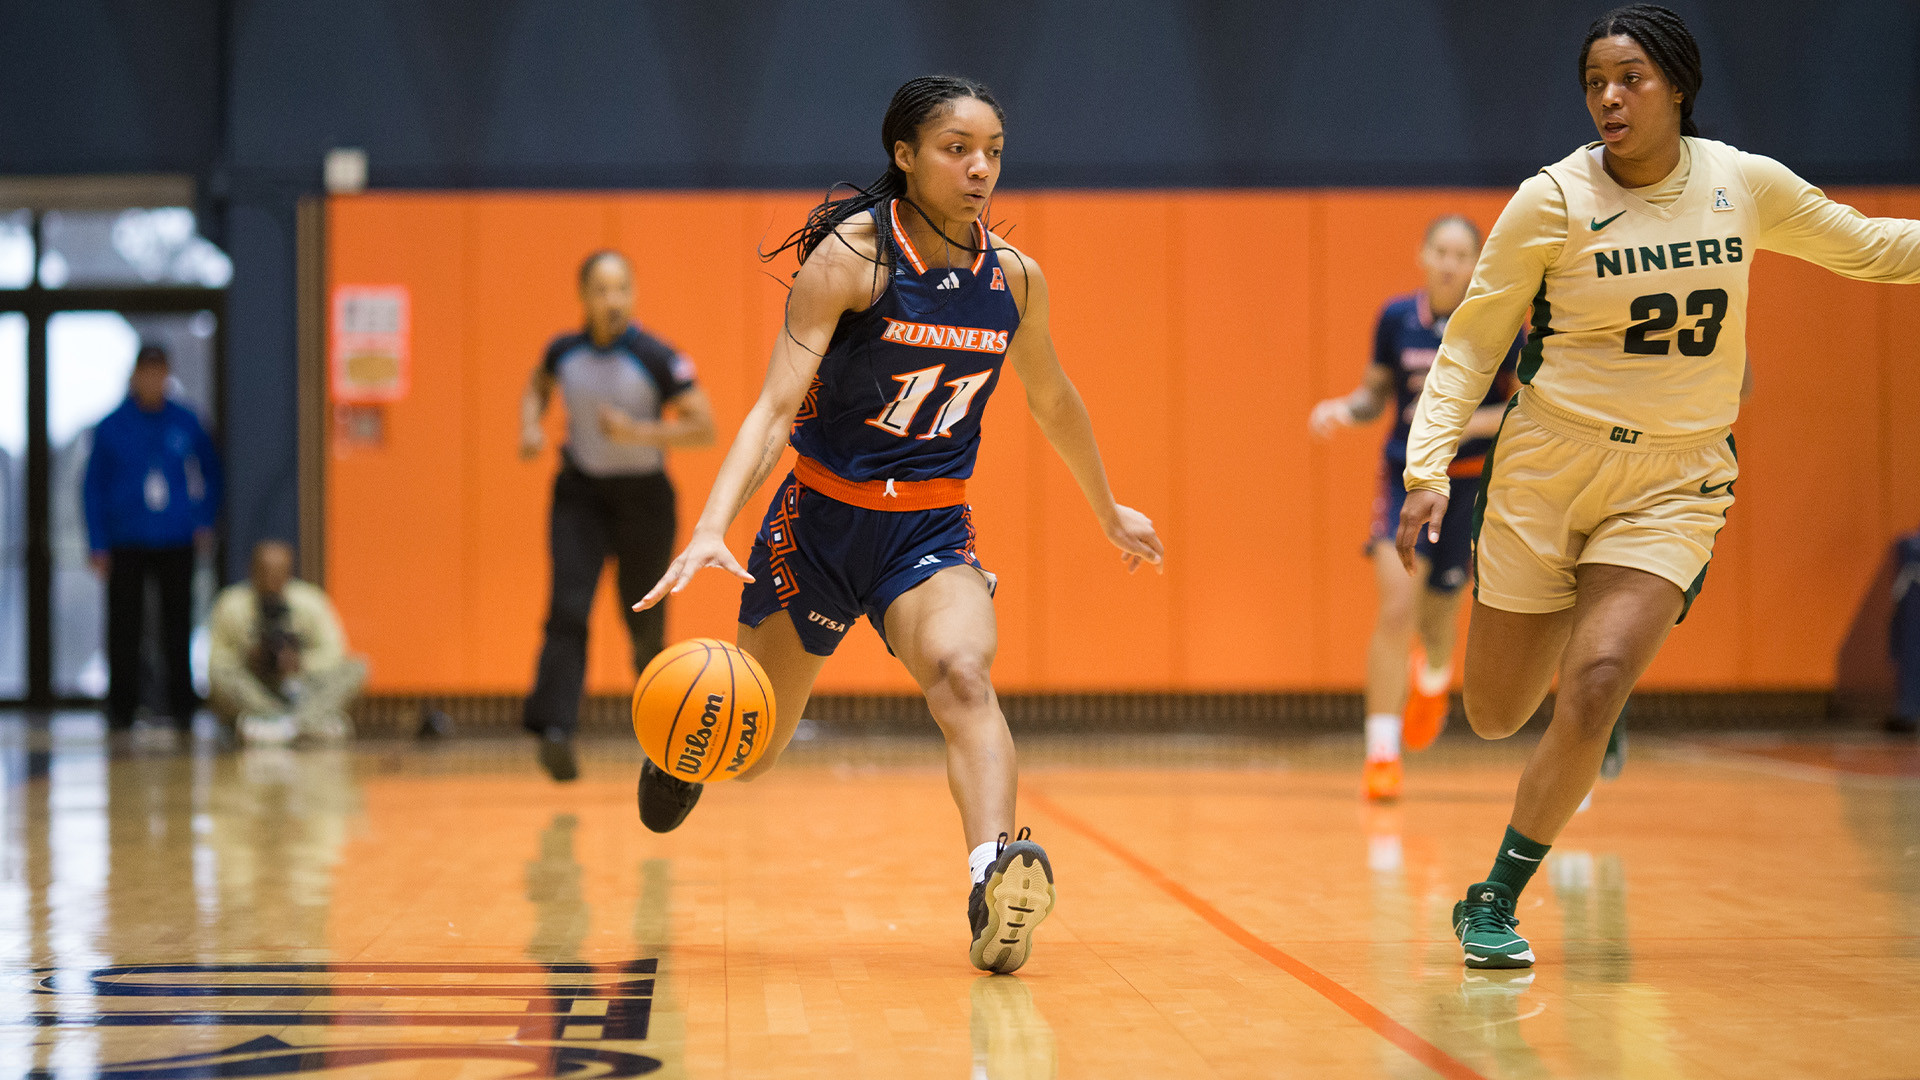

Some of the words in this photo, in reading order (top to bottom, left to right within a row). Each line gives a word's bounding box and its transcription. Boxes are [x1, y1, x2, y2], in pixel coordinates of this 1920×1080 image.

[1594, 237, 1743, 278] NINERS
[990, 267, 1005, 291] A
[882, 319, 1008, 353] RUNNERS
[1624, 288, 1728, 356] 23
[864, 363, 993, 440] 11
[1609, 426, 1643, 444] CLT
[807, 609, 846, 632] UTSA
[675, 693, 724, 775] Wilson
[725, 711, 759, 772] NCAA
